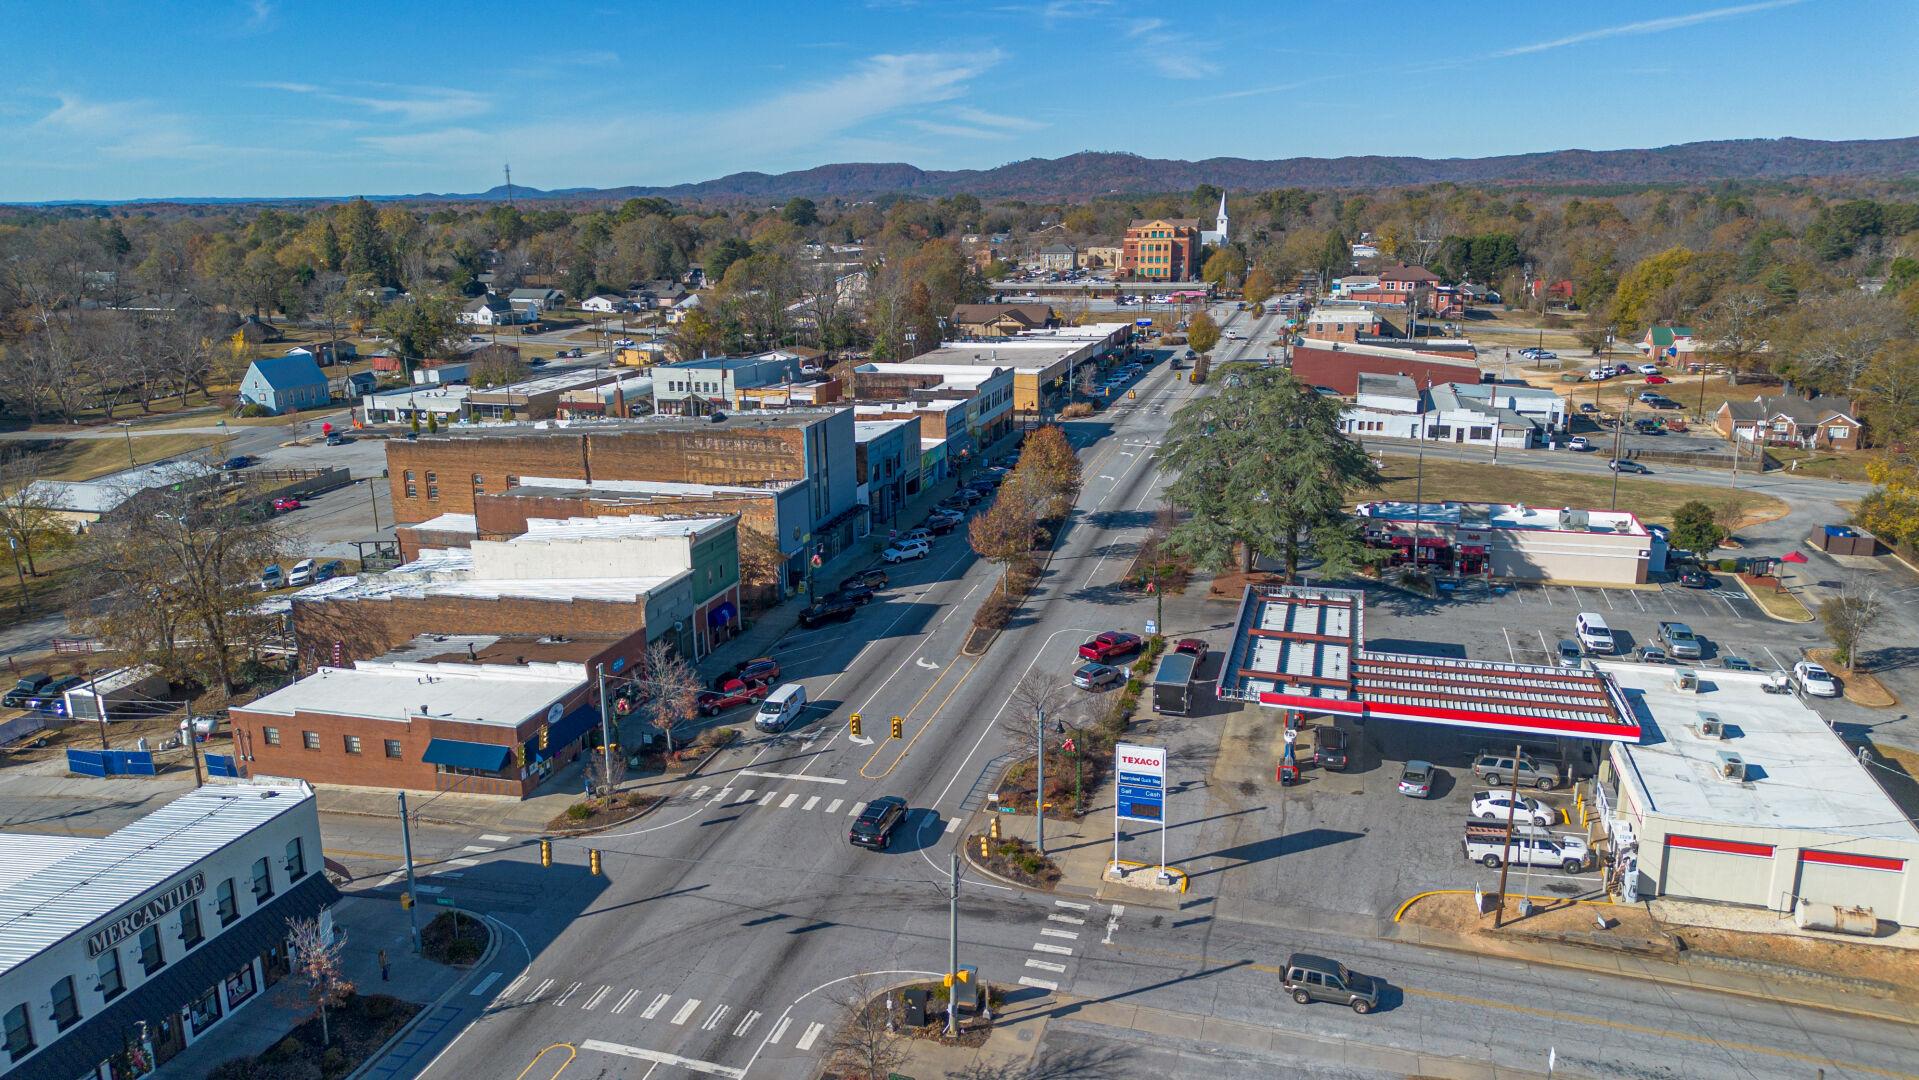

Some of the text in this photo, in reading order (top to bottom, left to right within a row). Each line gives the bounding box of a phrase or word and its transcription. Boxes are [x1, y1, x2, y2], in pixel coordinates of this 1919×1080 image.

[1121, 756, 1160, 766] TEXACO
[1145, 790, 1161, 798] Cash
[91, 874, 203, 955] MERCANTILE
